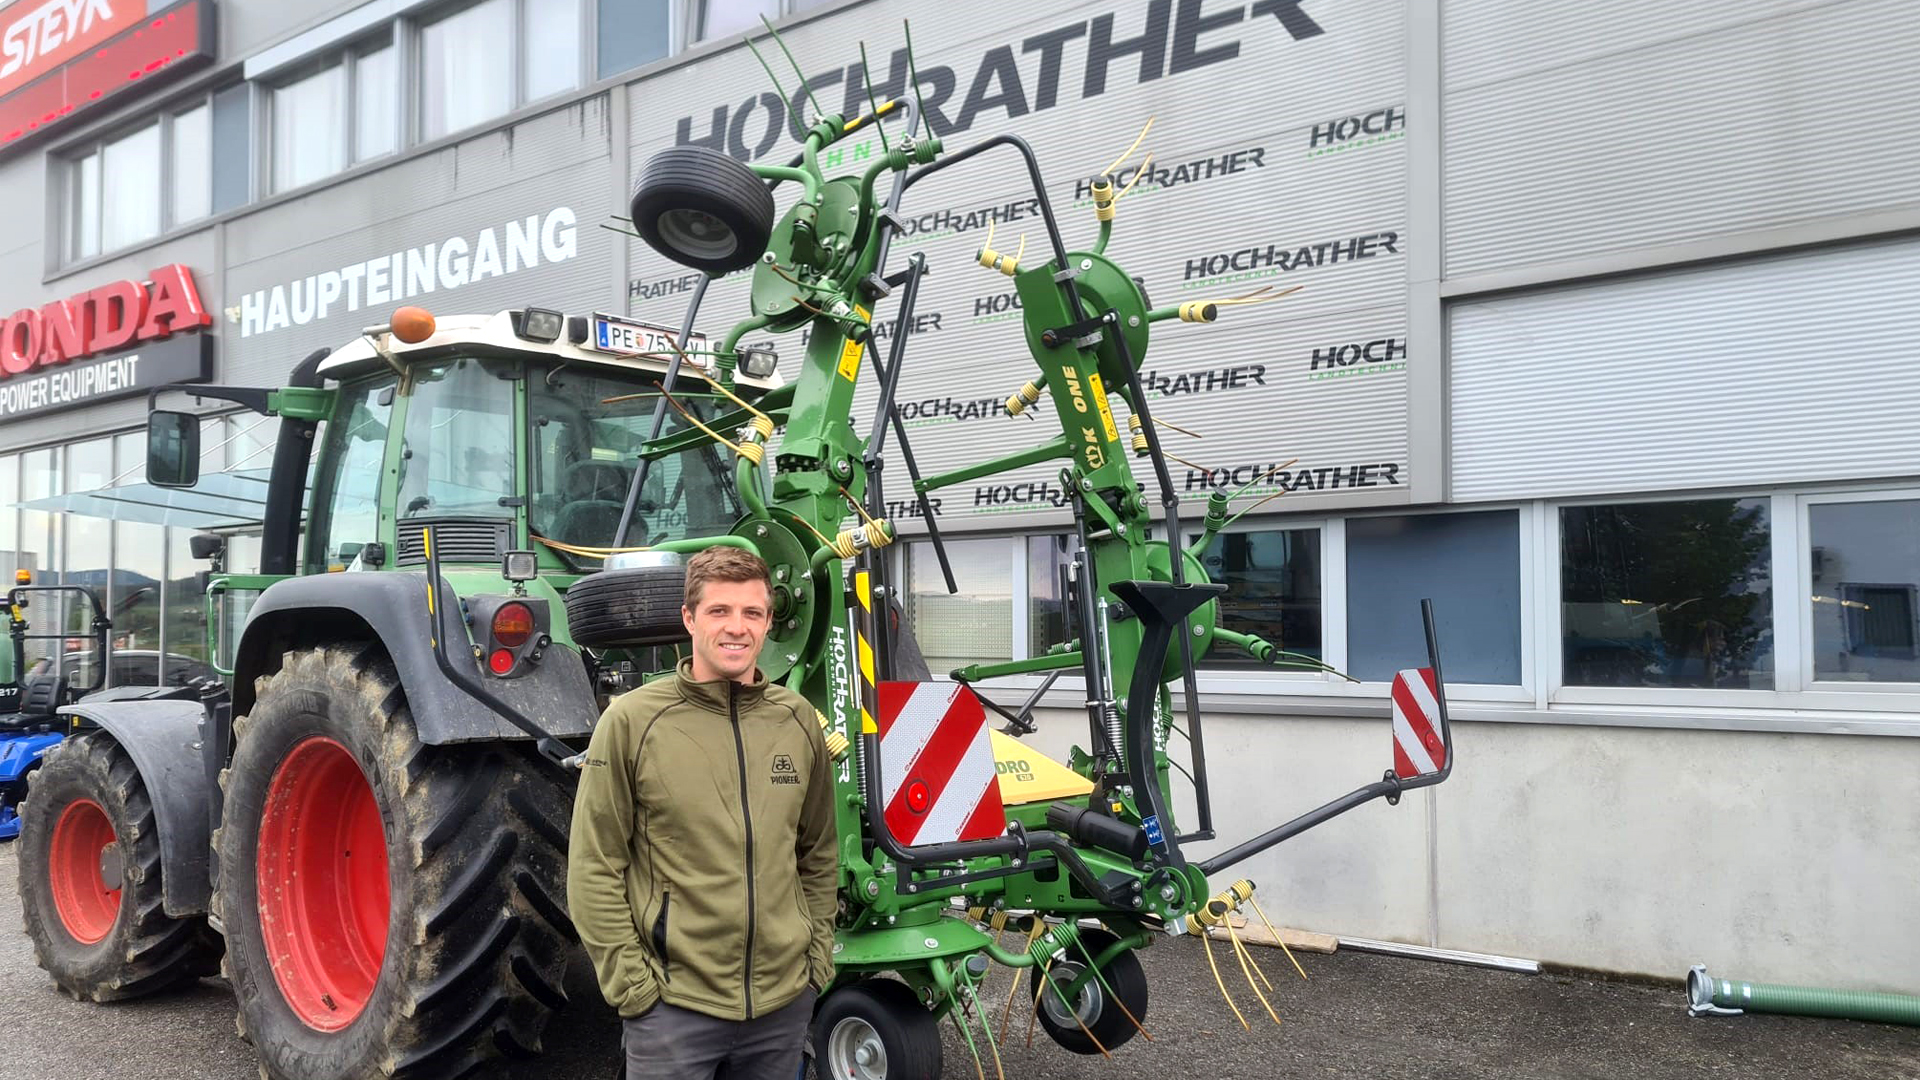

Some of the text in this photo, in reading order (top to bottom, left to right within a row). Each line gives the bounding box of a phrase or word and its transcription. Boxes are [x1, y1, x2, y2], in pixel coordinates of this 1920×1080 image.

[1074, 147, 1265, 200] HCHRATHER
[896, 199, 1039, 240] OCHRATHER
[241, 207, 577, 338] HAUPTEINGANG
[1184, 232, 1398, 280] HOCHRATHER
[0, 264, 212, 378] ONDA
[611, 327, 633, 348] PE
[0, 355, 139, 415] POWER EQUIPMENT
[1138, 364, 1266, 396] HRATHER
[1185, 463, 1399, 492] HOCHRATHER
[995, 760, 1030, 774] DRO
